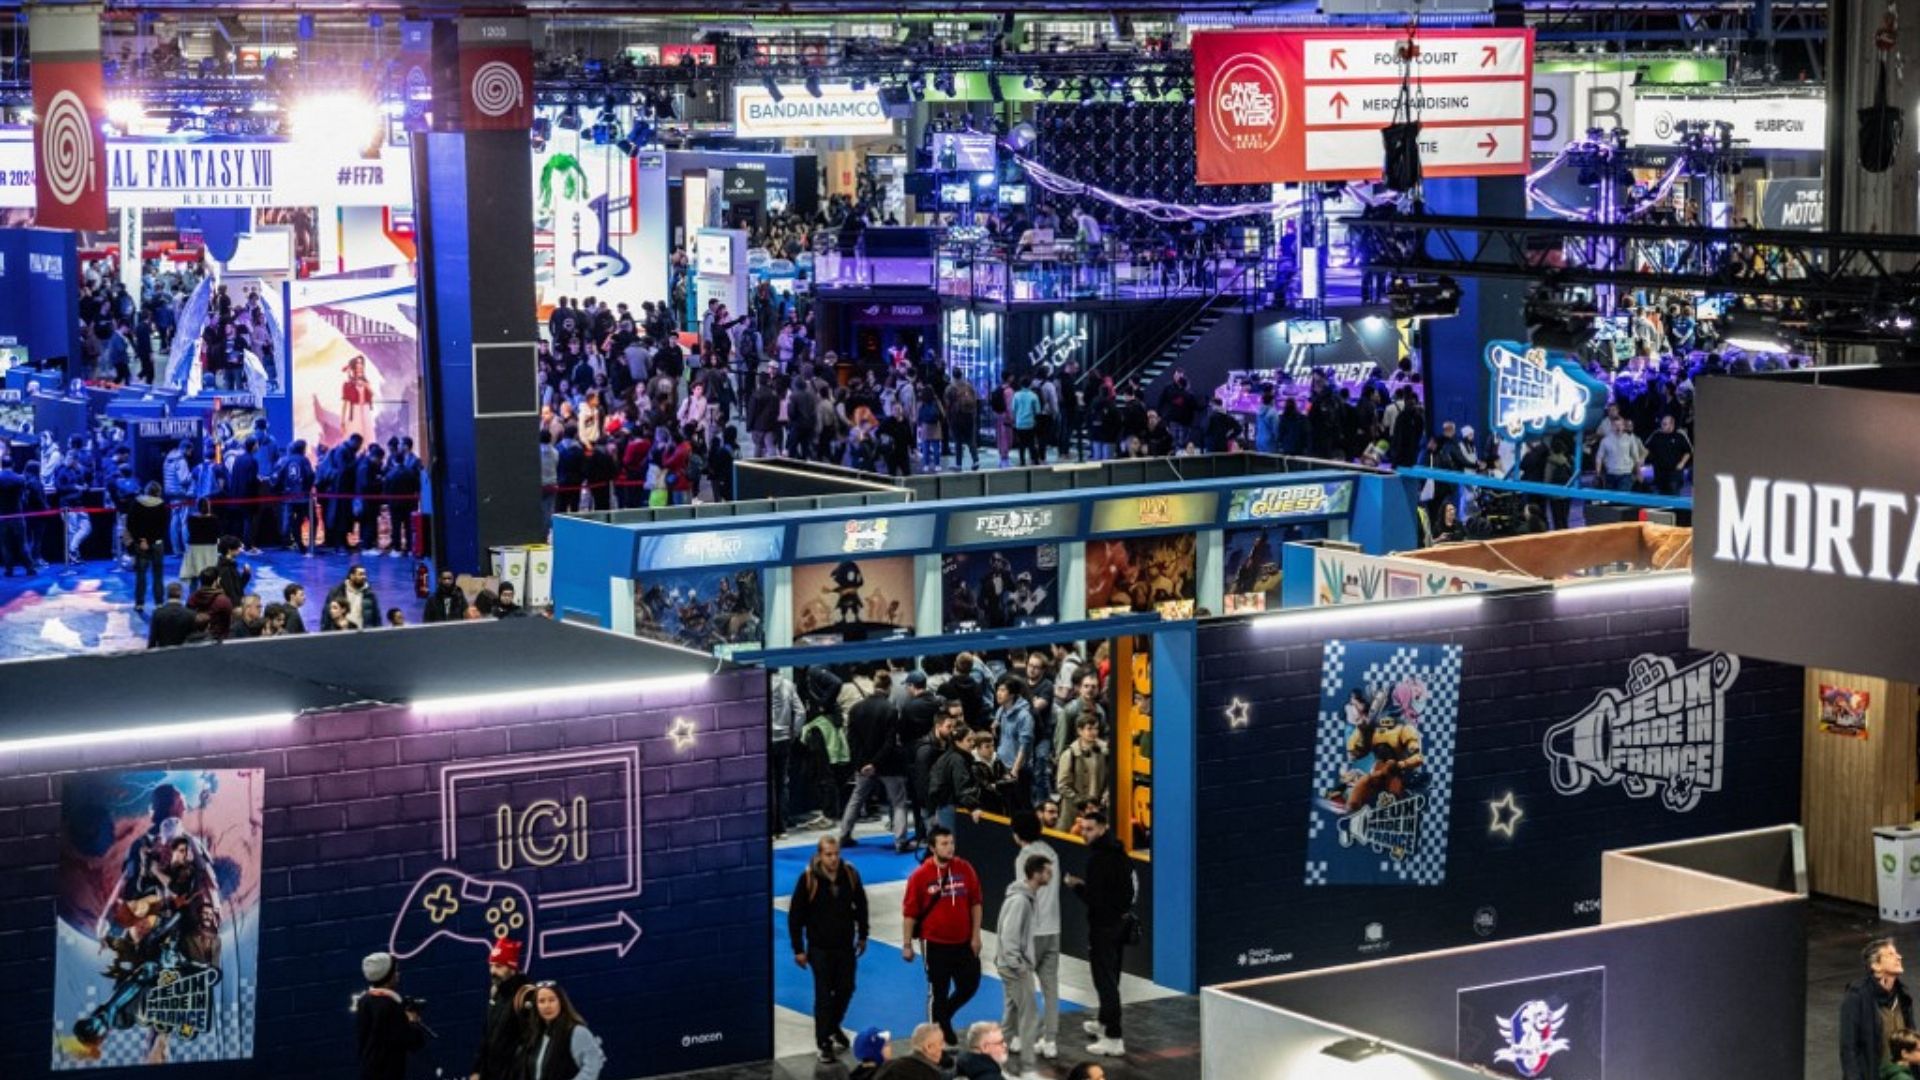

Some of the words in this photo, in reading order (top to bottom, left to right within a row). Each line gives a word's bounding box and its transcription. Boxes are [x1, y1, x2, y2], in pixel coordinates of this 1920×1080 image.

[1415, 52, 1458, 64] COURT
[750, 103, 814, 118] BANDAI
[817, 101, 880, 116] NAMCO
[1220, 93, 1273, 111] GAMES
[1363, 97, 1469, 110] MERCHANDISING
[1232, 109, 1275, 127] WEEK
[1419, 141, 1438, 153] TIE
[148, 150, 244, 187] FANTASY
[337, 167, 384, 185] #FF7R
[183, 194, 272, 205] REBIRTH
[1612, 662, 1712, 726] JEUX
[1612, 712, 1684, 747] MADE
[1686, 705, 1712, 742] IN
[1611, 743, 1712, 786] FRANCE
[498, 796, 587, 870] ICI
